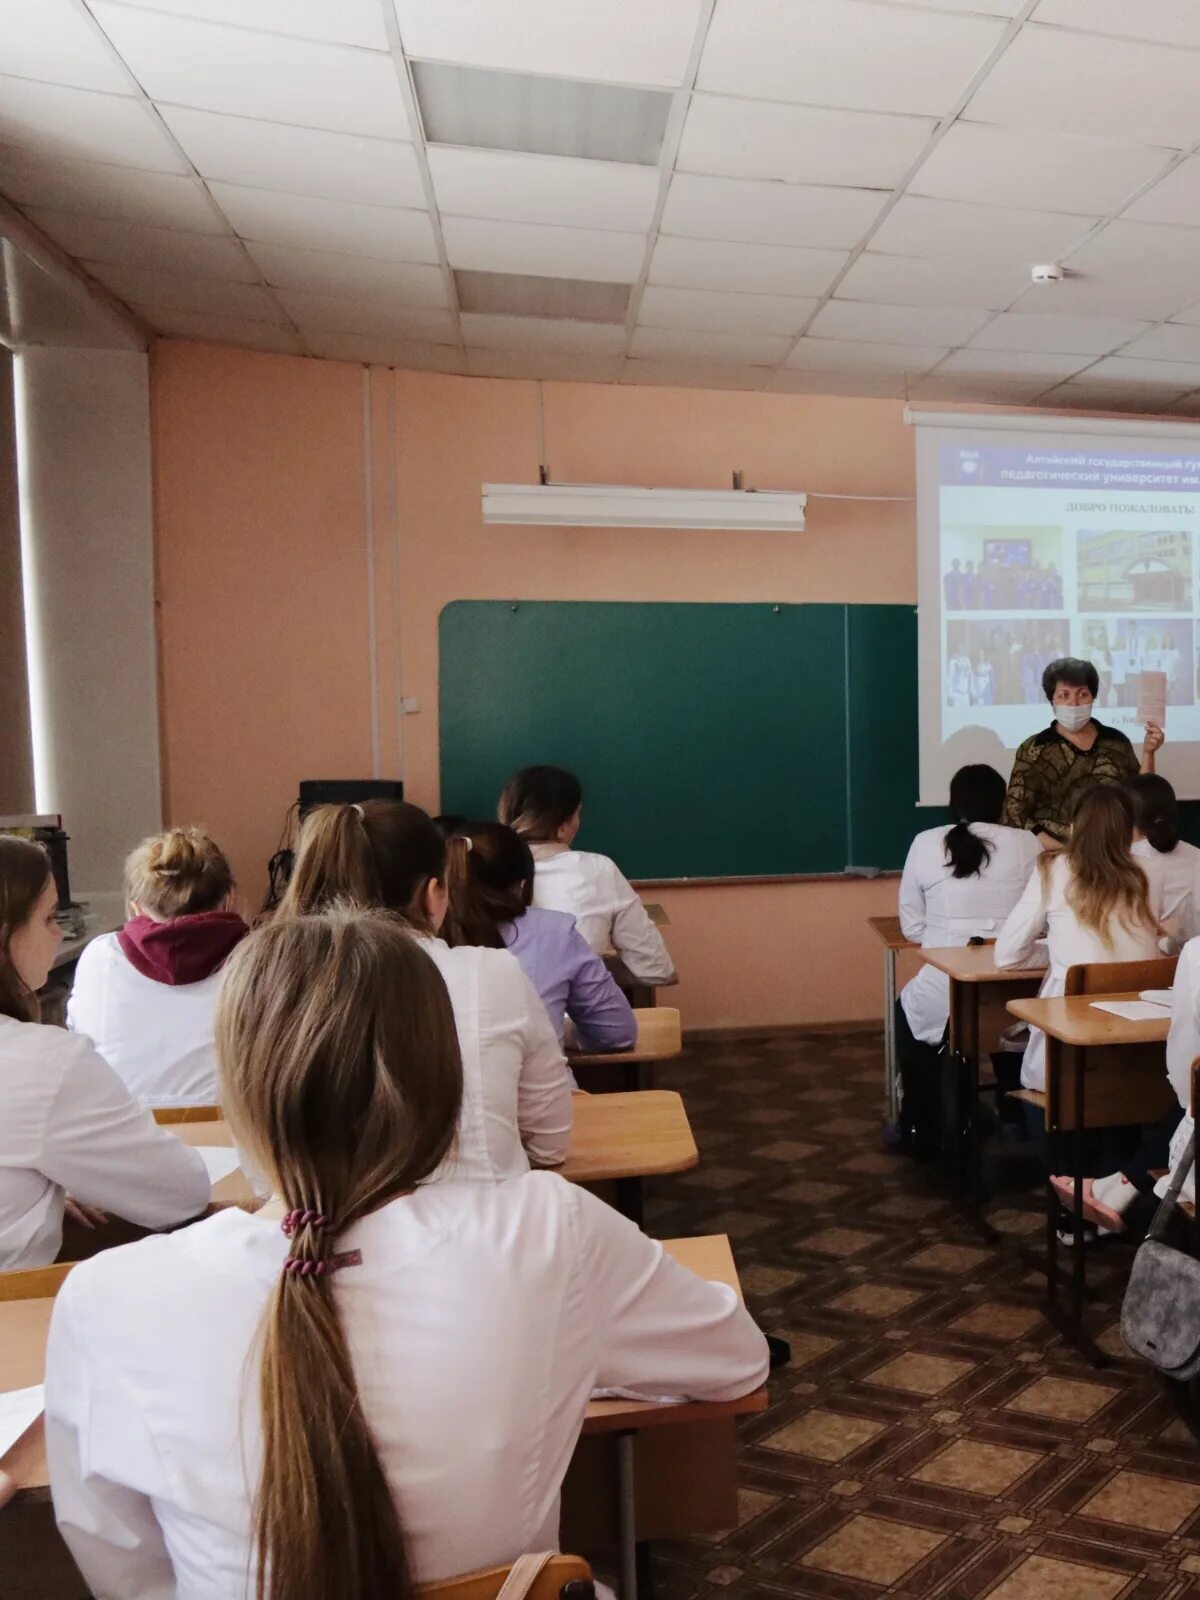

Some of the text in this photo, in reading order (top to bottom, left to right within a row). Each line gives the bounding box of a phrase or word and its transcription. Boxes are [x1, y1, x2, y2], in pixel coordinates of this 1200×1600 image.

[1001, 469, 1100, 482] педагогический
[1102, 473, 1178, 486] университет
[1066, 502, 1106, 514] ДОБРО
